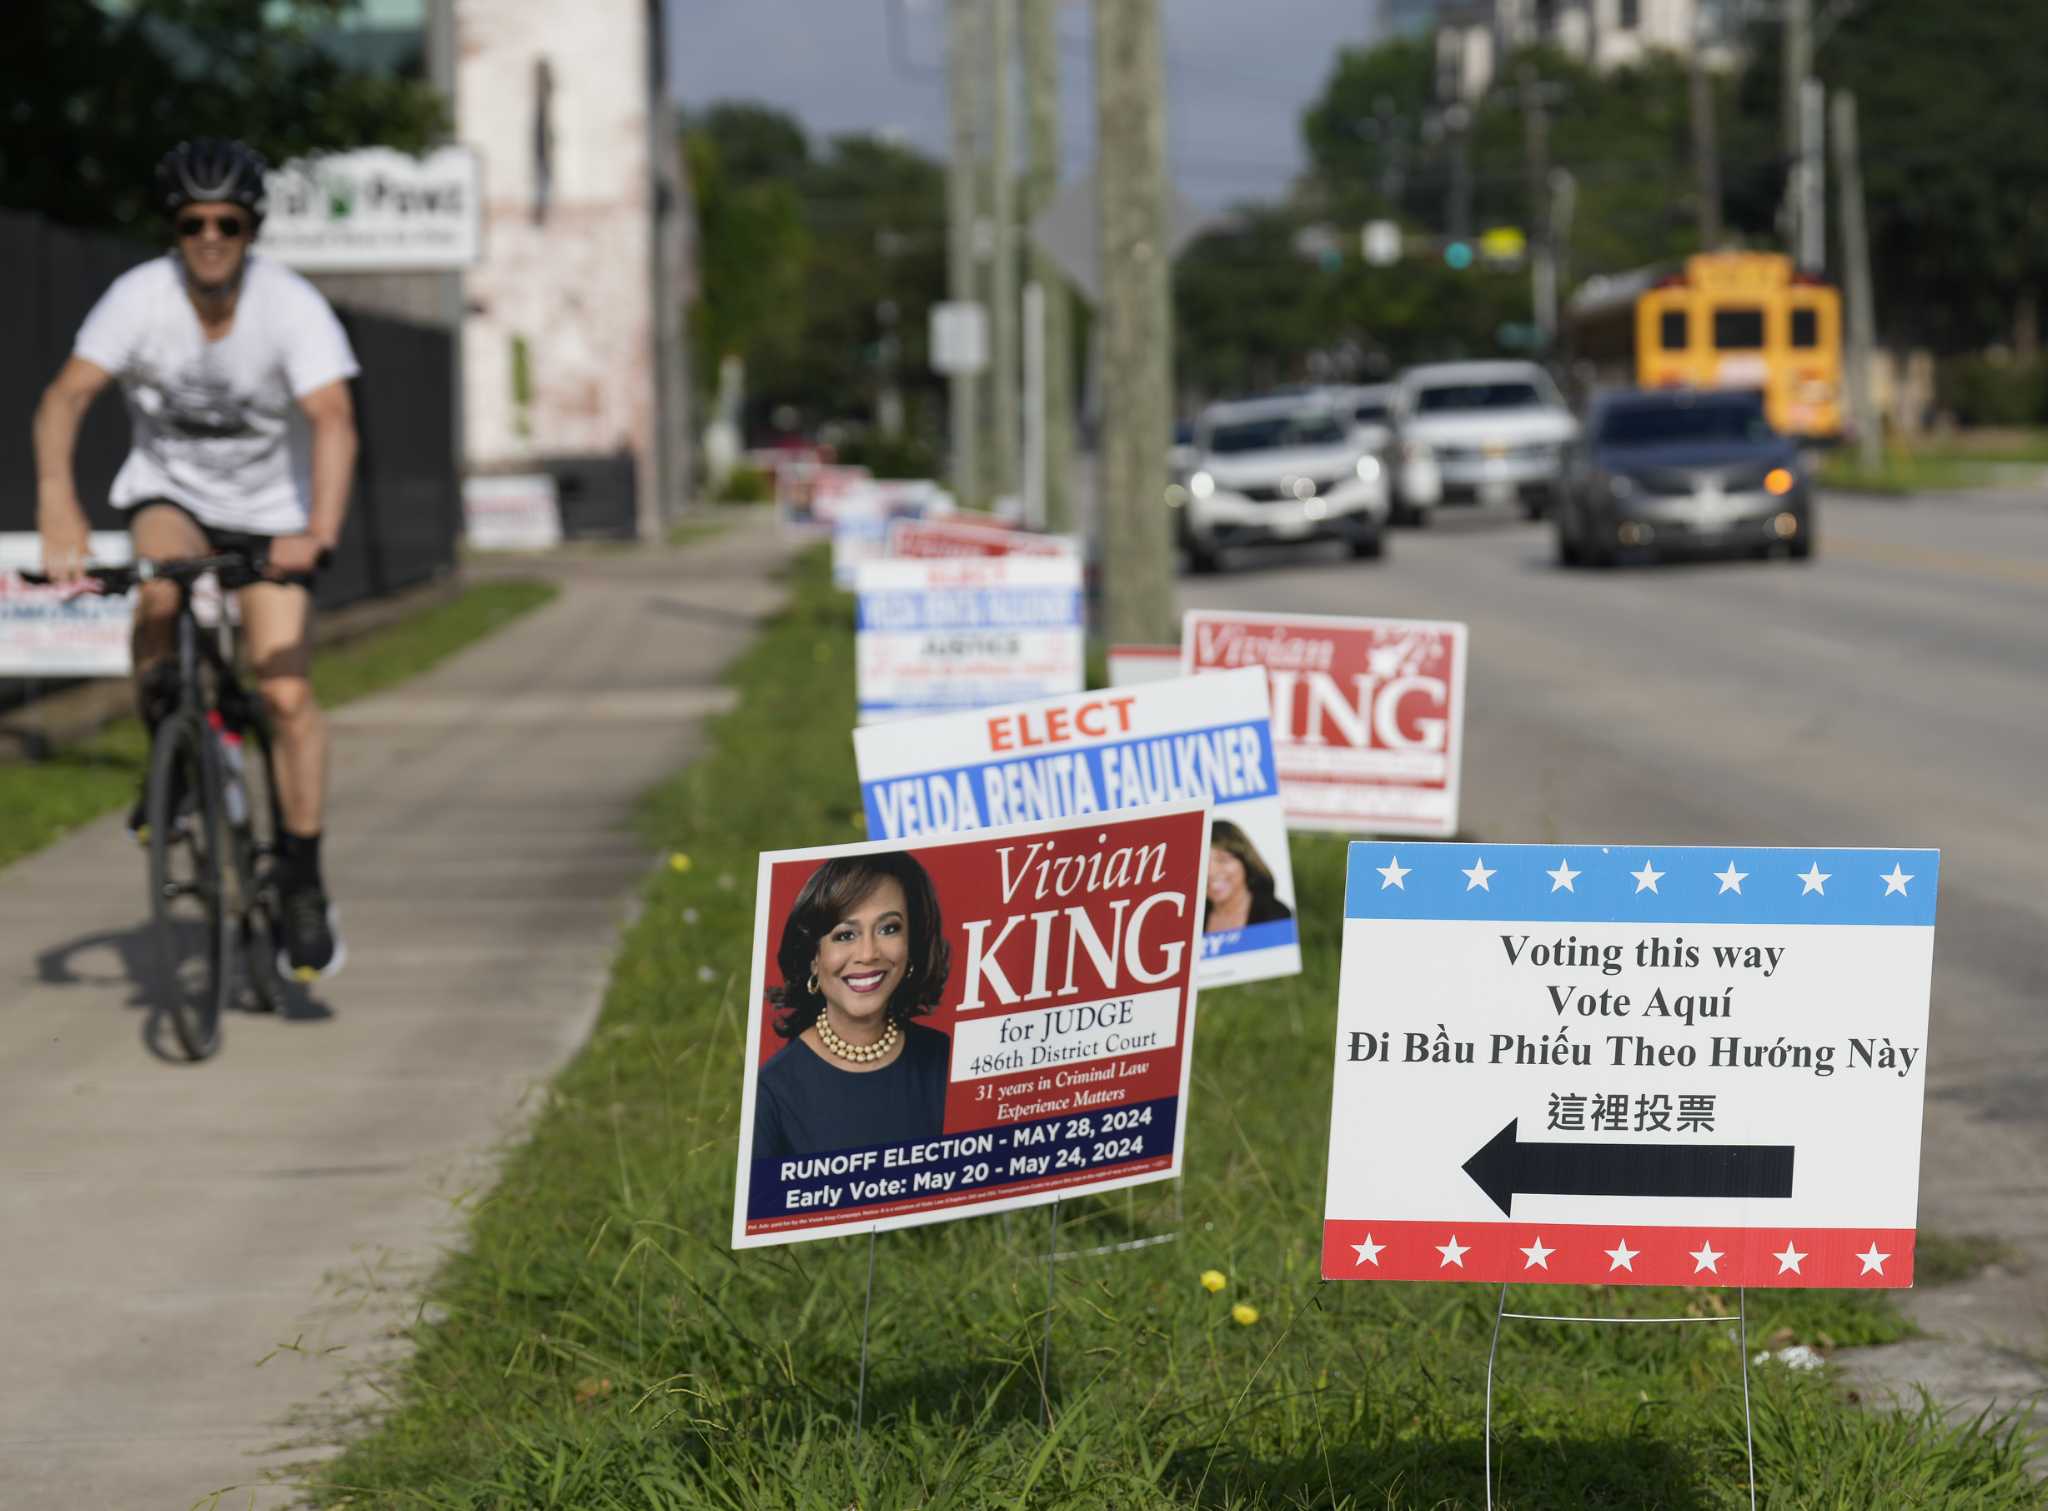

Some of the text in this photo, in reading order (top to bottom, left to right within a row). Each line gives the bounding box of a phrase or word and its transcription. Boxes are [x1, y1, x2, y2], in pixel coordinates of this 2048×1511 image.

[1198, 623, 1334, 671] Vivian
[987, 697, 1136, 752] ELECT
[1270, 668, 1449, 752] ING
[873, 727, 1268, 838] VELDA RENITA FAULKNER
[996, 833, 1167, 905] Vivian
[956, 892, 1186, 1012] KING
[1499, 935, 1785, 977] Voting this way
[1000, 1000, 1134, 1044] for JUDGE
[1546, 985, 1734, 1026] Vote Aquí
[970, 1031, 1157, 1076] 486th District Court
[1347, 1023, 1919, 1078] Đi Bầu Phiếu Theo Hướng Này
[975, 1061, 1150, 1101] 31 years in Criminal Law
[997, 1087, 1126, 1121] Experience Matters
[1547, 1092, 1717, 1133] 這裡投票
[780, 1151, 878, 1182] RUNOFF
[883, 1134, 993, 1167] ELECTION
[1013, 1123, 1060, 1148] MAY
[1066, 1116, 1096, 1139] 28,
[1101, 1106, 1153, 1133] 2024
[785, 1184, 843, 1209] Early
[849, 1178, 907, 1200] Vote:
[913, 1171, 956, 1191] May
[961, 1163, 989, 1184] 20
[1009, 1154, 1050, 1176] May
[1055, 1148, 1086, 1168] 24,
[1091, 1135, 1144, 1162] 2024
